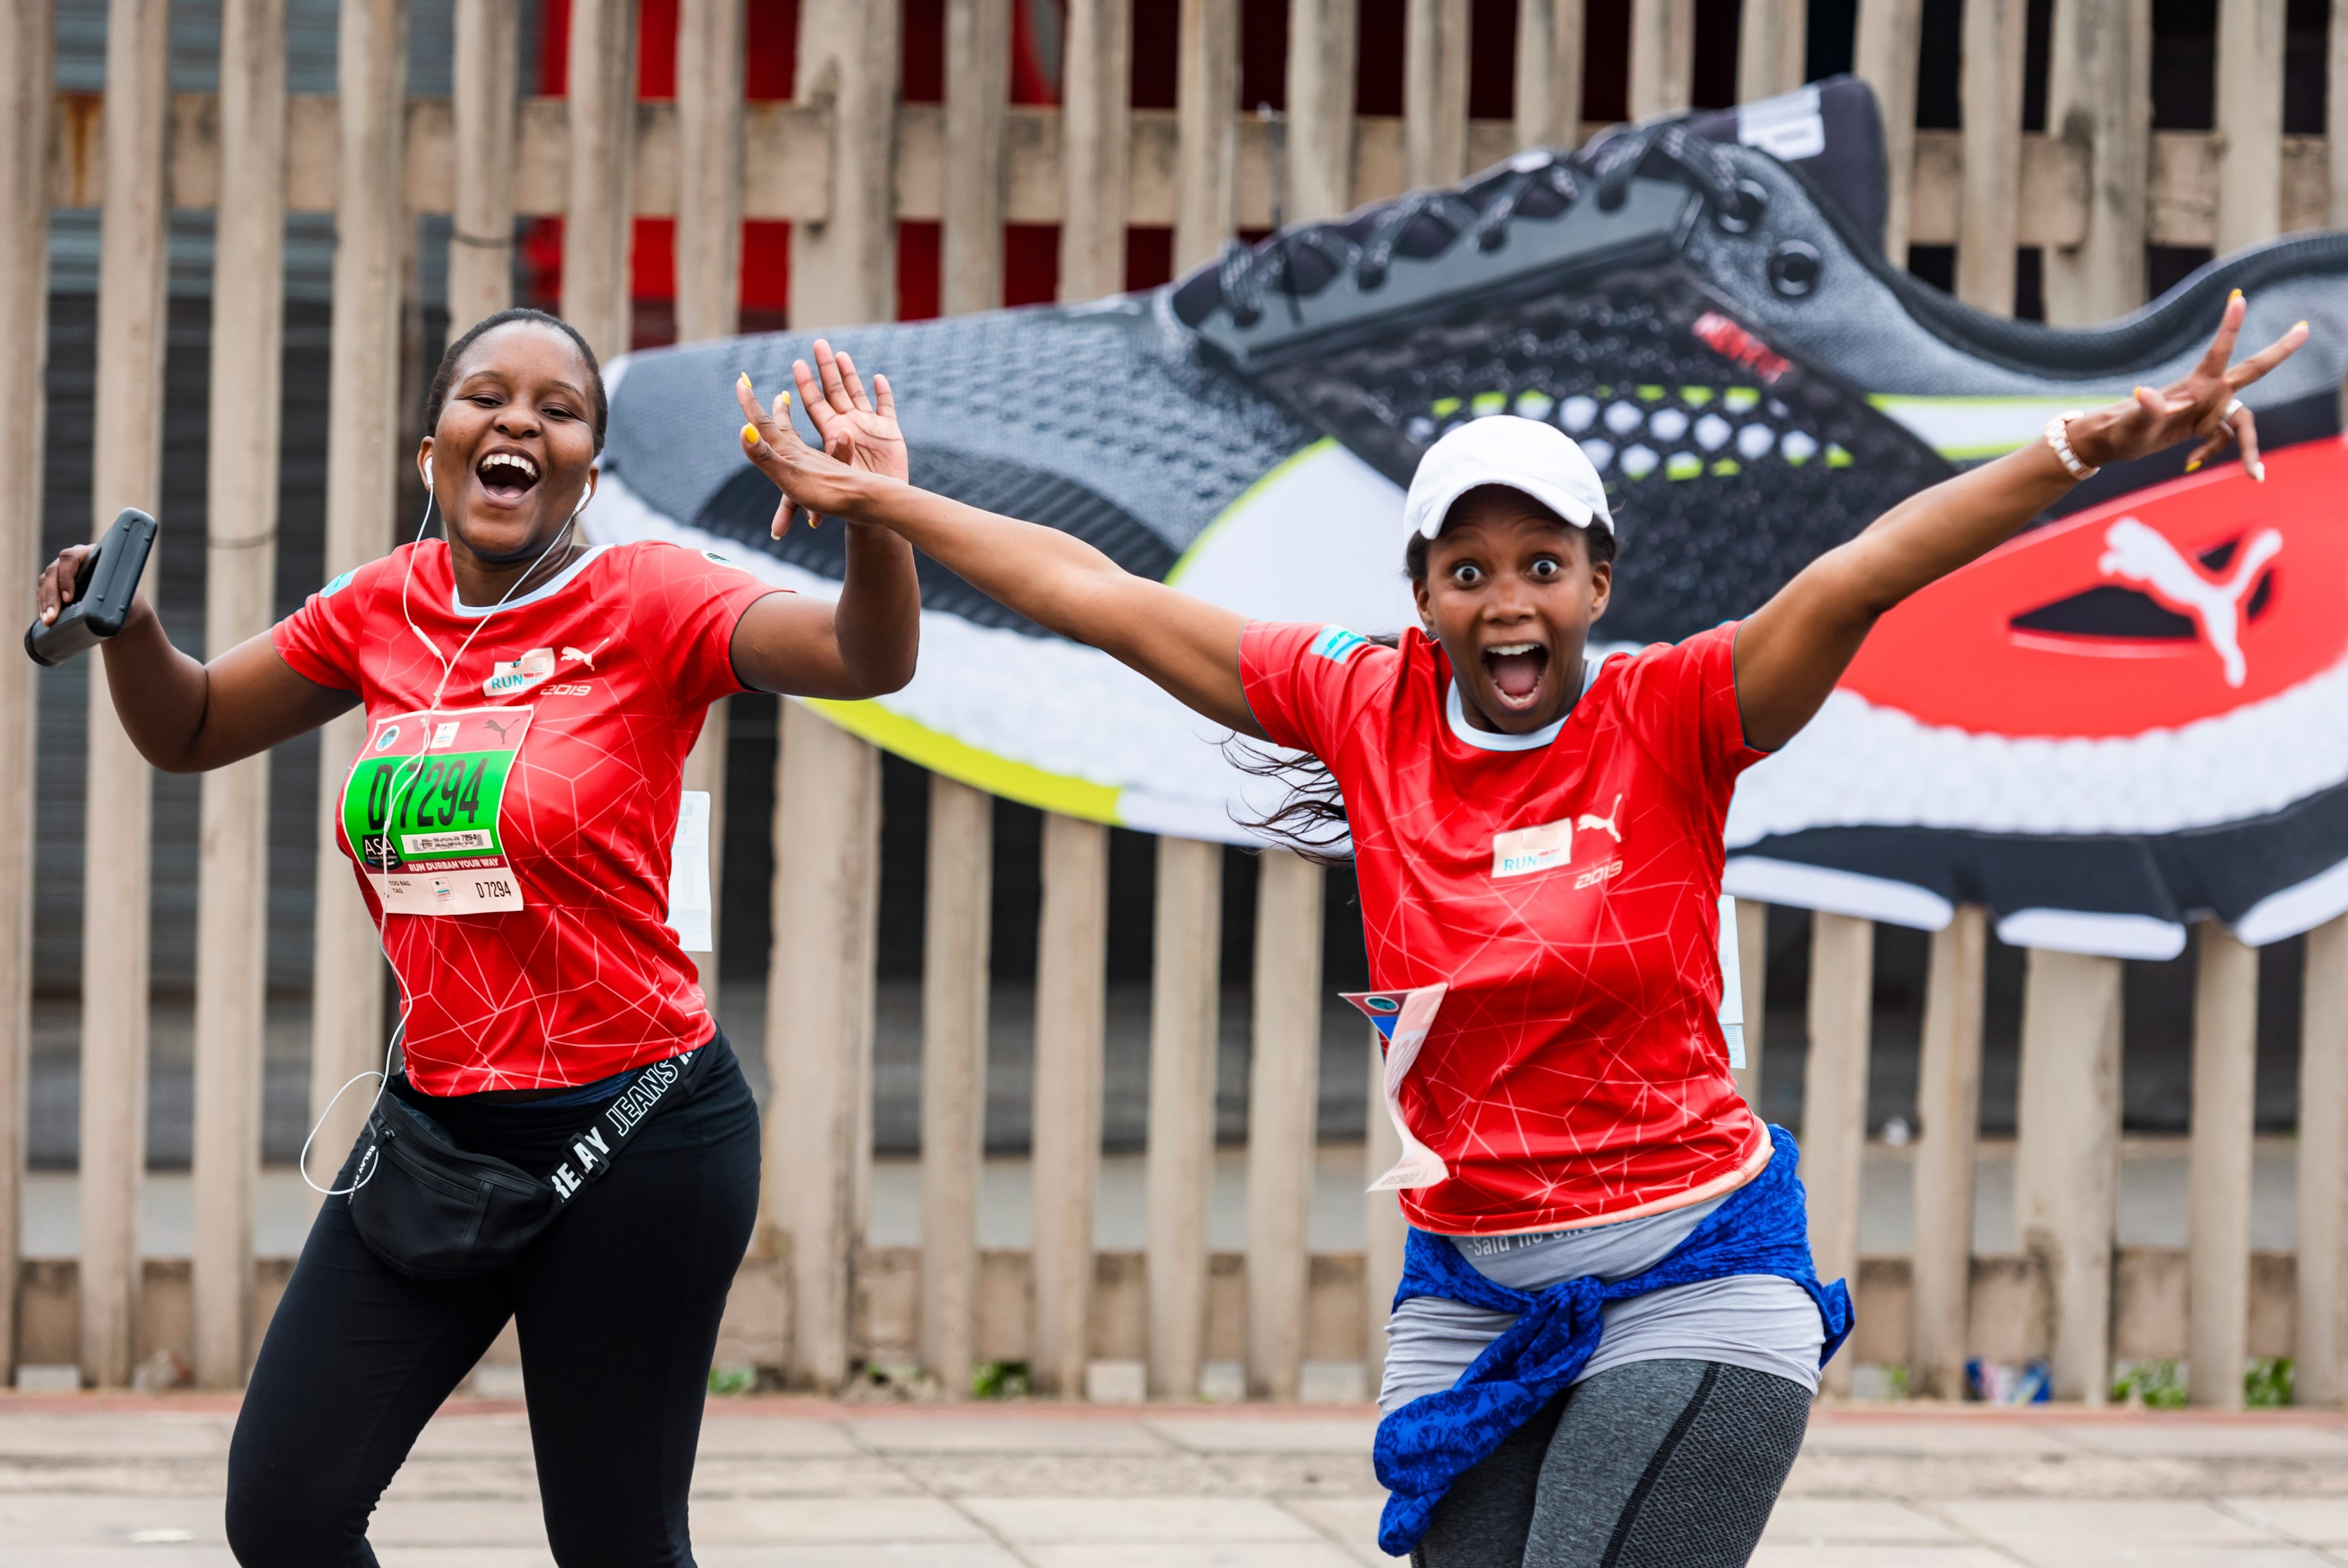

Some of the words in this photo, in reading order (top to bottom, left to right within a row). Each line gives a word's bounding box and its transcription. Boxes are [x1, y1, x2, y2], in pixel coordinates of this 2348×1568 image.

[491, 674, 523, 689] RUN
[540, 684, 592, 696] 2019
[400, 758, 489, 828] 7294
[408, 863, 425, 872] RUN
[425, 861, 459, 871] DURBAN
[458, 859, 482, 868] YOUR
[480, 858, 499, 867] WAY
[1503, 855, 1538, 871] RUN
[1574, 860, 1624, 890] 2019
[475, 882, 485, 898] D
[483, 881, 512, 897] 7294
[605, 1059, 678, 1137] JEANS
